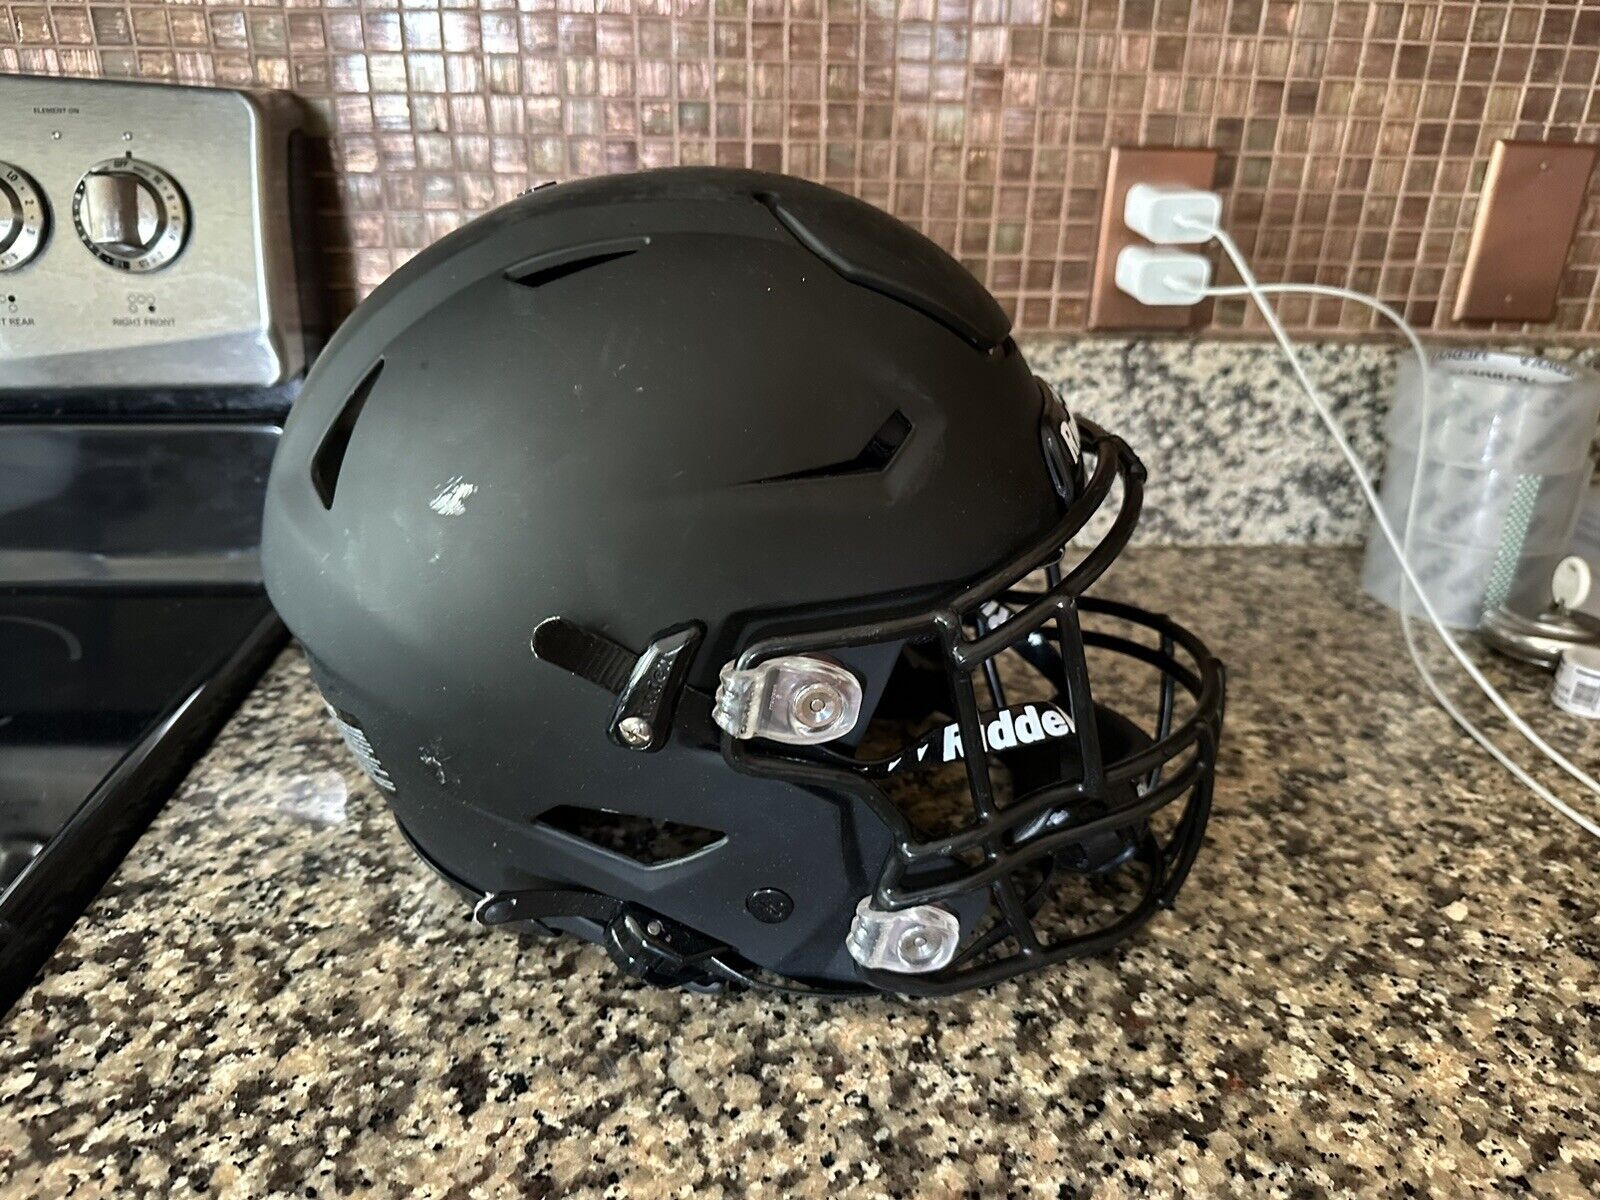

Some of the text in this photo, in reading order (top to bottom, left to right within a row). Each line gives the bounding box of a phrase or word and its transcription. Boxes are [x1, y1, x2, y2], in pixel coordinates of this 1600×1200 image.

[6, 170, 18, 181] LO
[9, 317, 35, 326] REAR
[112, 317, 175, 327] RIGHT FRONT
